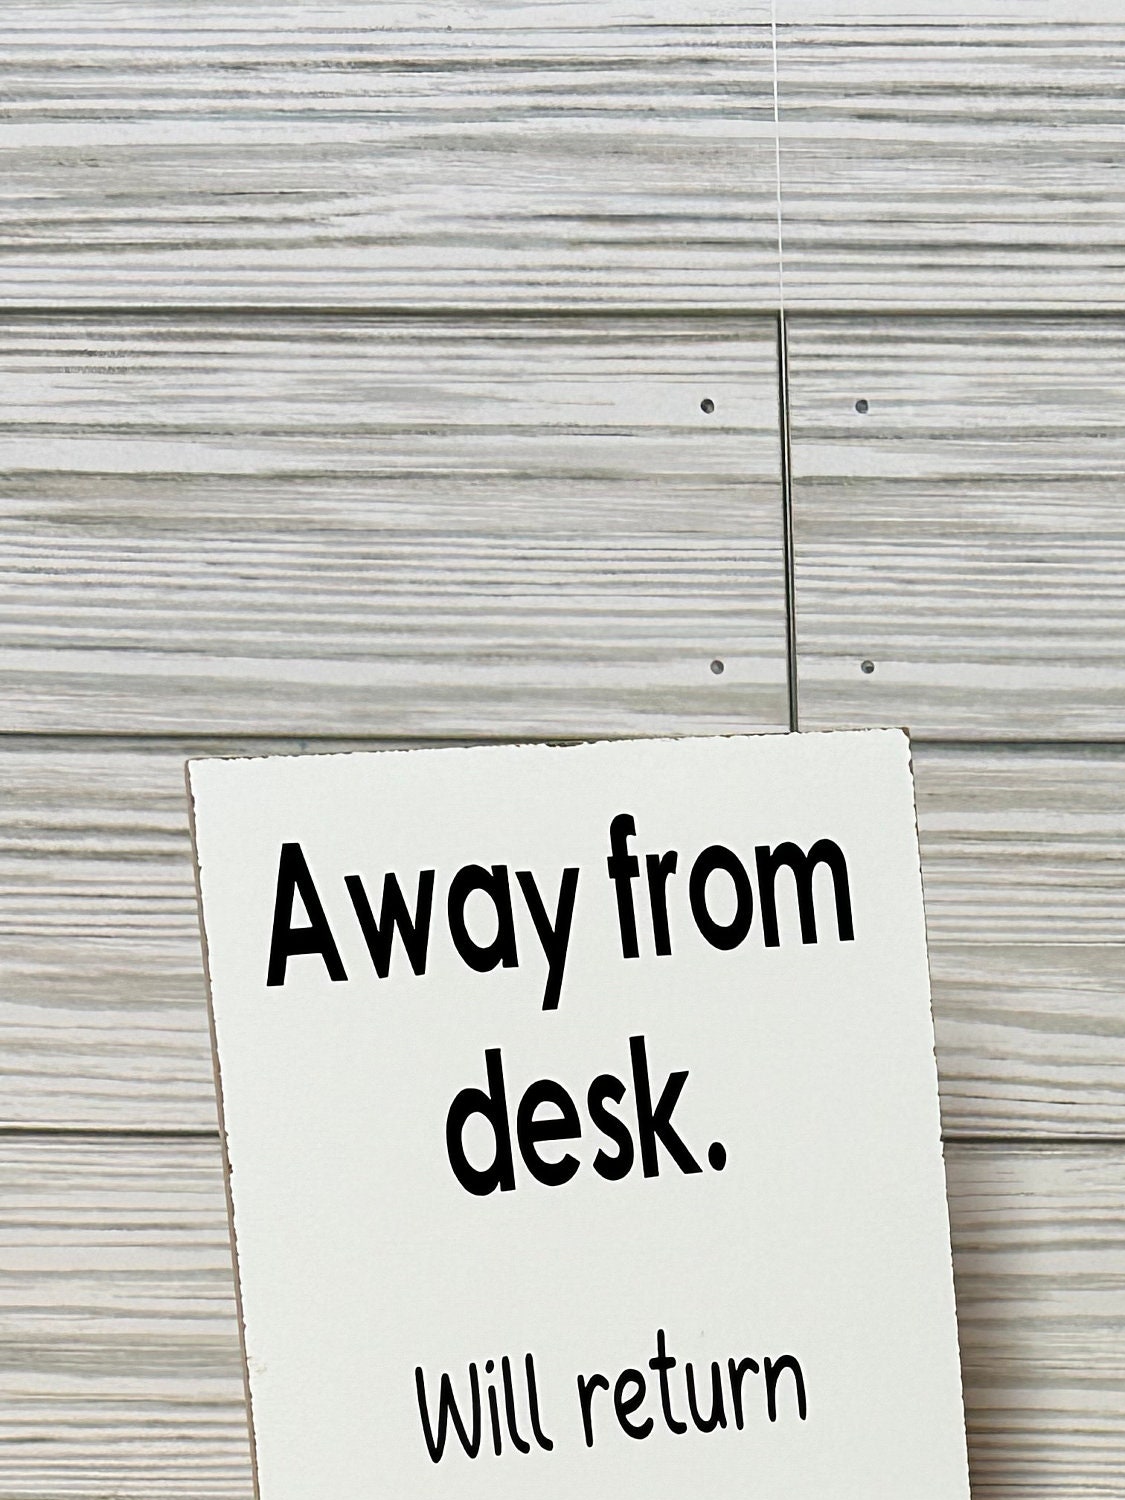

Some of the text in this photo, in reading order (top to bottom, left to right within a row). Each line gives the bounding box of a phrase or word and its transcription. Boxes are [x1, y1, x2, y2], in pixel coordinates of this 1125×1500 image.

[267, 813, 855, 1011] Away from
[445, 1035, 727, 1197] desk.
[414, 1328, 807, 1464] Will return
